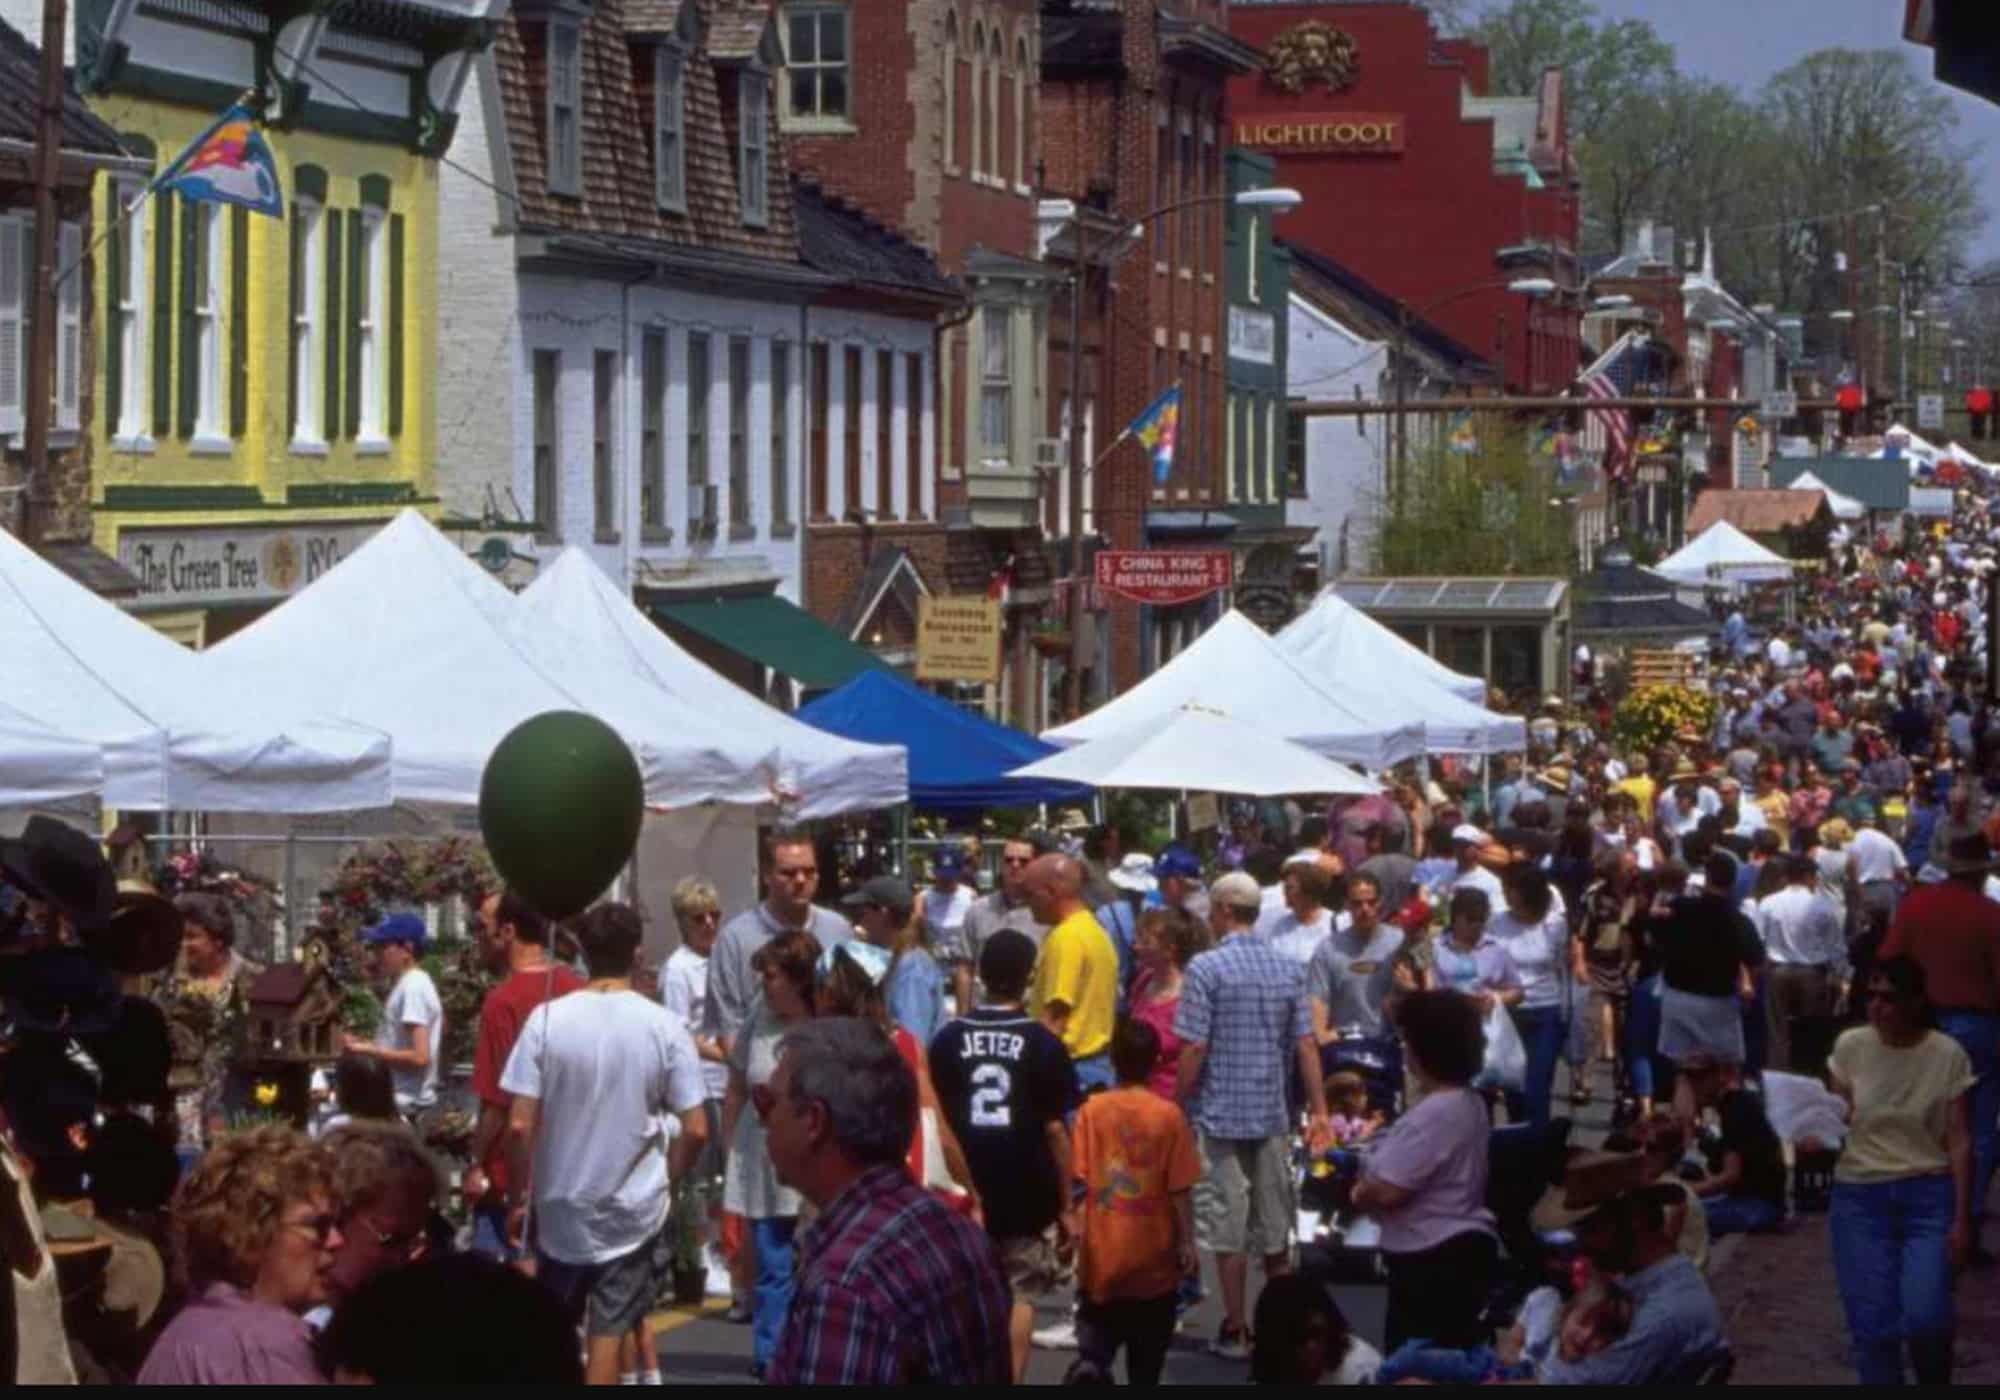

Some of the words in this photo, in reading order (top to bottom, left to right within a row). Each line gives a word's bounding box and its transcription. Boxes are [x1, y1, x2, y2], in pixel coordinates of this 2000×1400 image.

[1238, 123, 1397, 145] LIGHTFOOT
[135, 543, 167, 594] The
[169, 541, 221, 592] Green
[222, 541, 258, 589] Tree
[1119, 556, 1165, 570] CHINA
[1169, 556, 1208, 570] KING
[1114, 573, 1209, 586] RESTAURANT
[960, 1030, 1025, 1061] JETER
[971, 1063, 1011, 1126] 2
